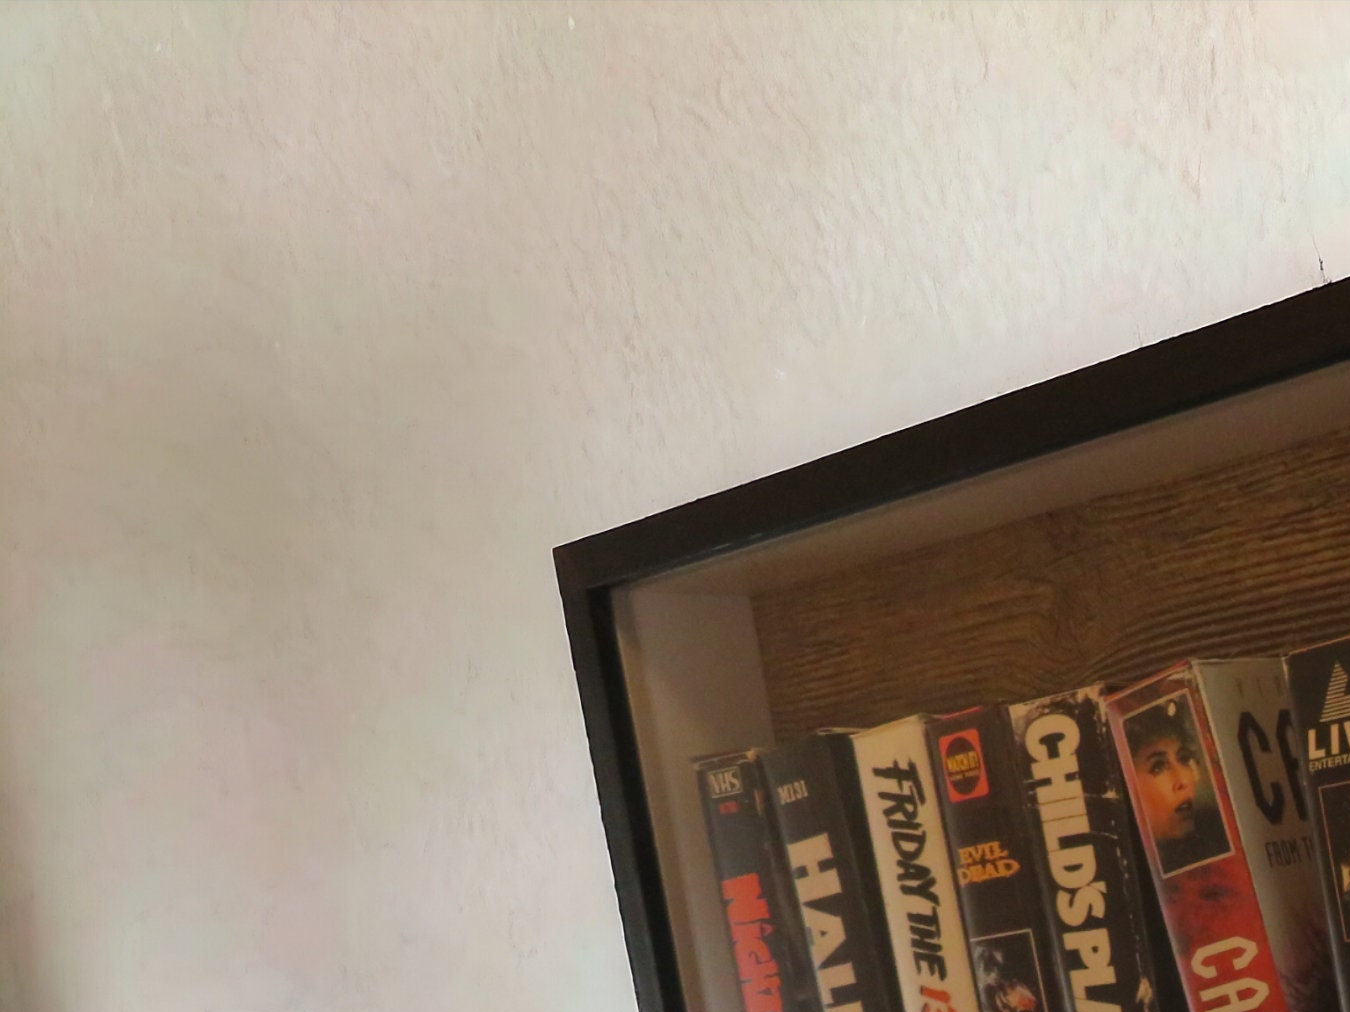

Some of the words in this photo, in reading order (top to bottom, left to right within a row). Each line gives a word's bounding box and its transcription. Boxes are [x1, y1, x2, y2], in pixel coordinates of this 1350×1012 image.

[709, 768, 742, 796] VHS
[1025, 713, 1107, 927] CHILD'S
[958, 841, 1009, 864] EVIL
[872, 757, 940, 906] FRIDAY
[907, 906, 948, 981] THE
[957, 859, 1021, 887] DEAD
